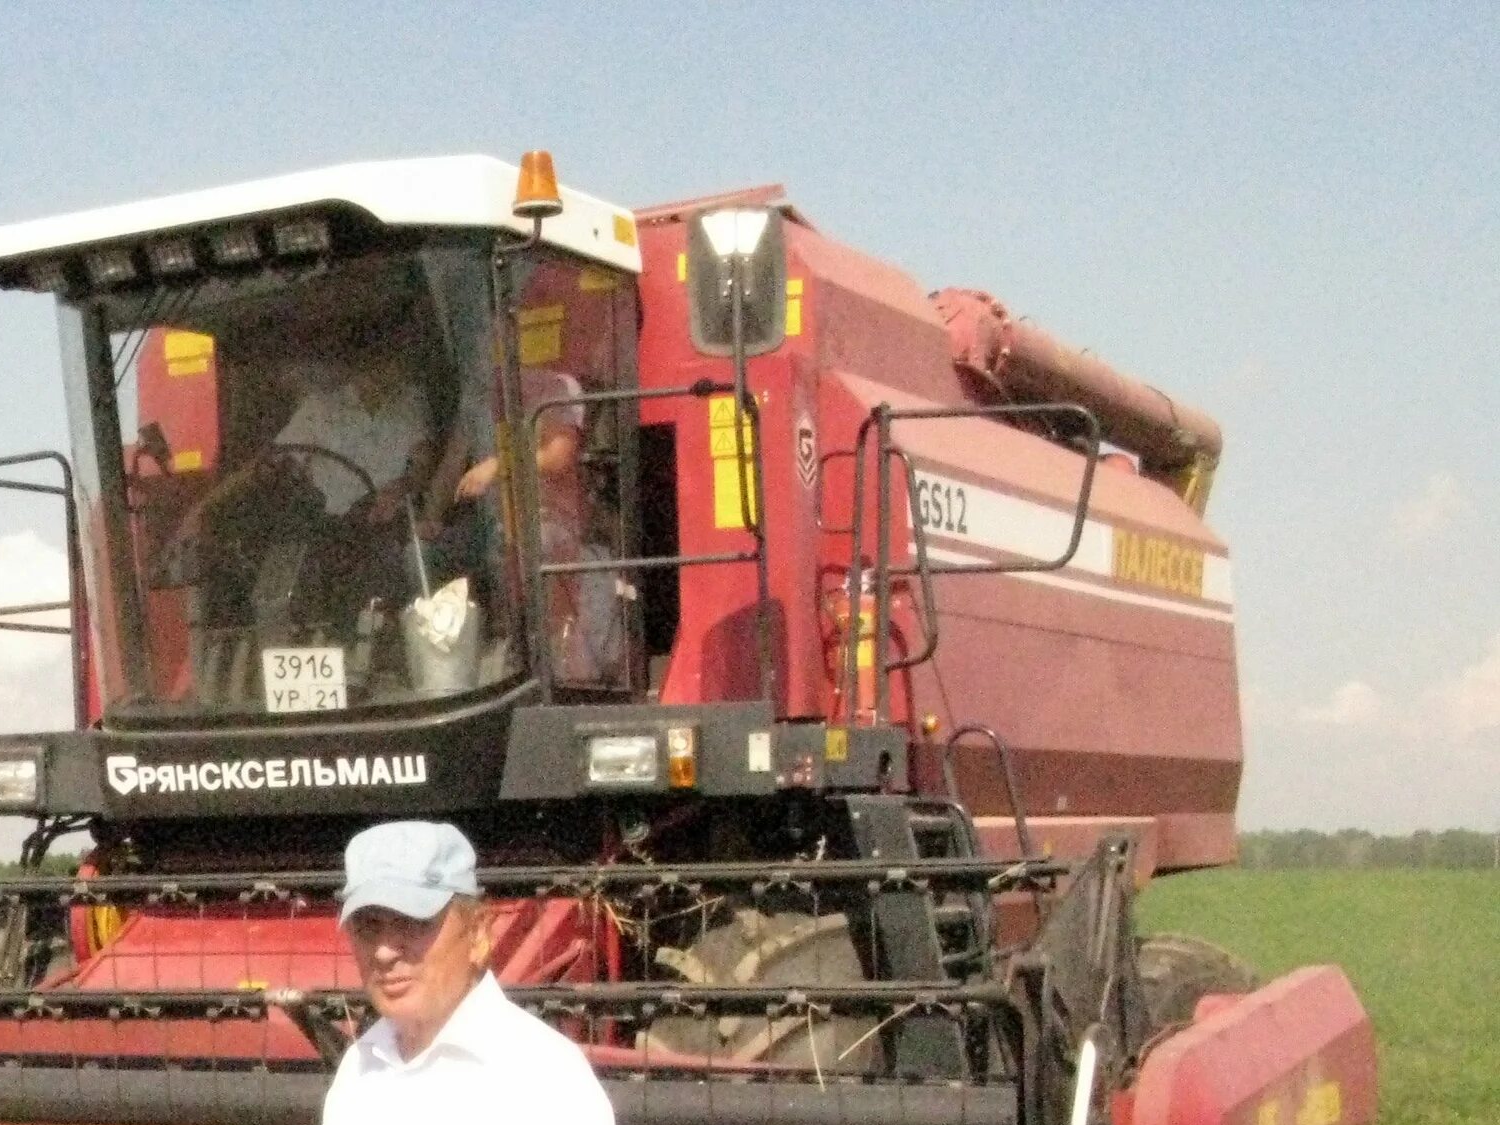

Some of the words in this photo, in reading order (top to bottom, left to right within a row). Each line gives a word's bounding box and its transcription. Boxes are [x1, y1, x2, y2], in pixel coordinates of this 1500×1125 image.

[915, 480, 968, 534] GS12
[273, 654, 333, 680] 3916
[315, 689, 340, 709] 21
